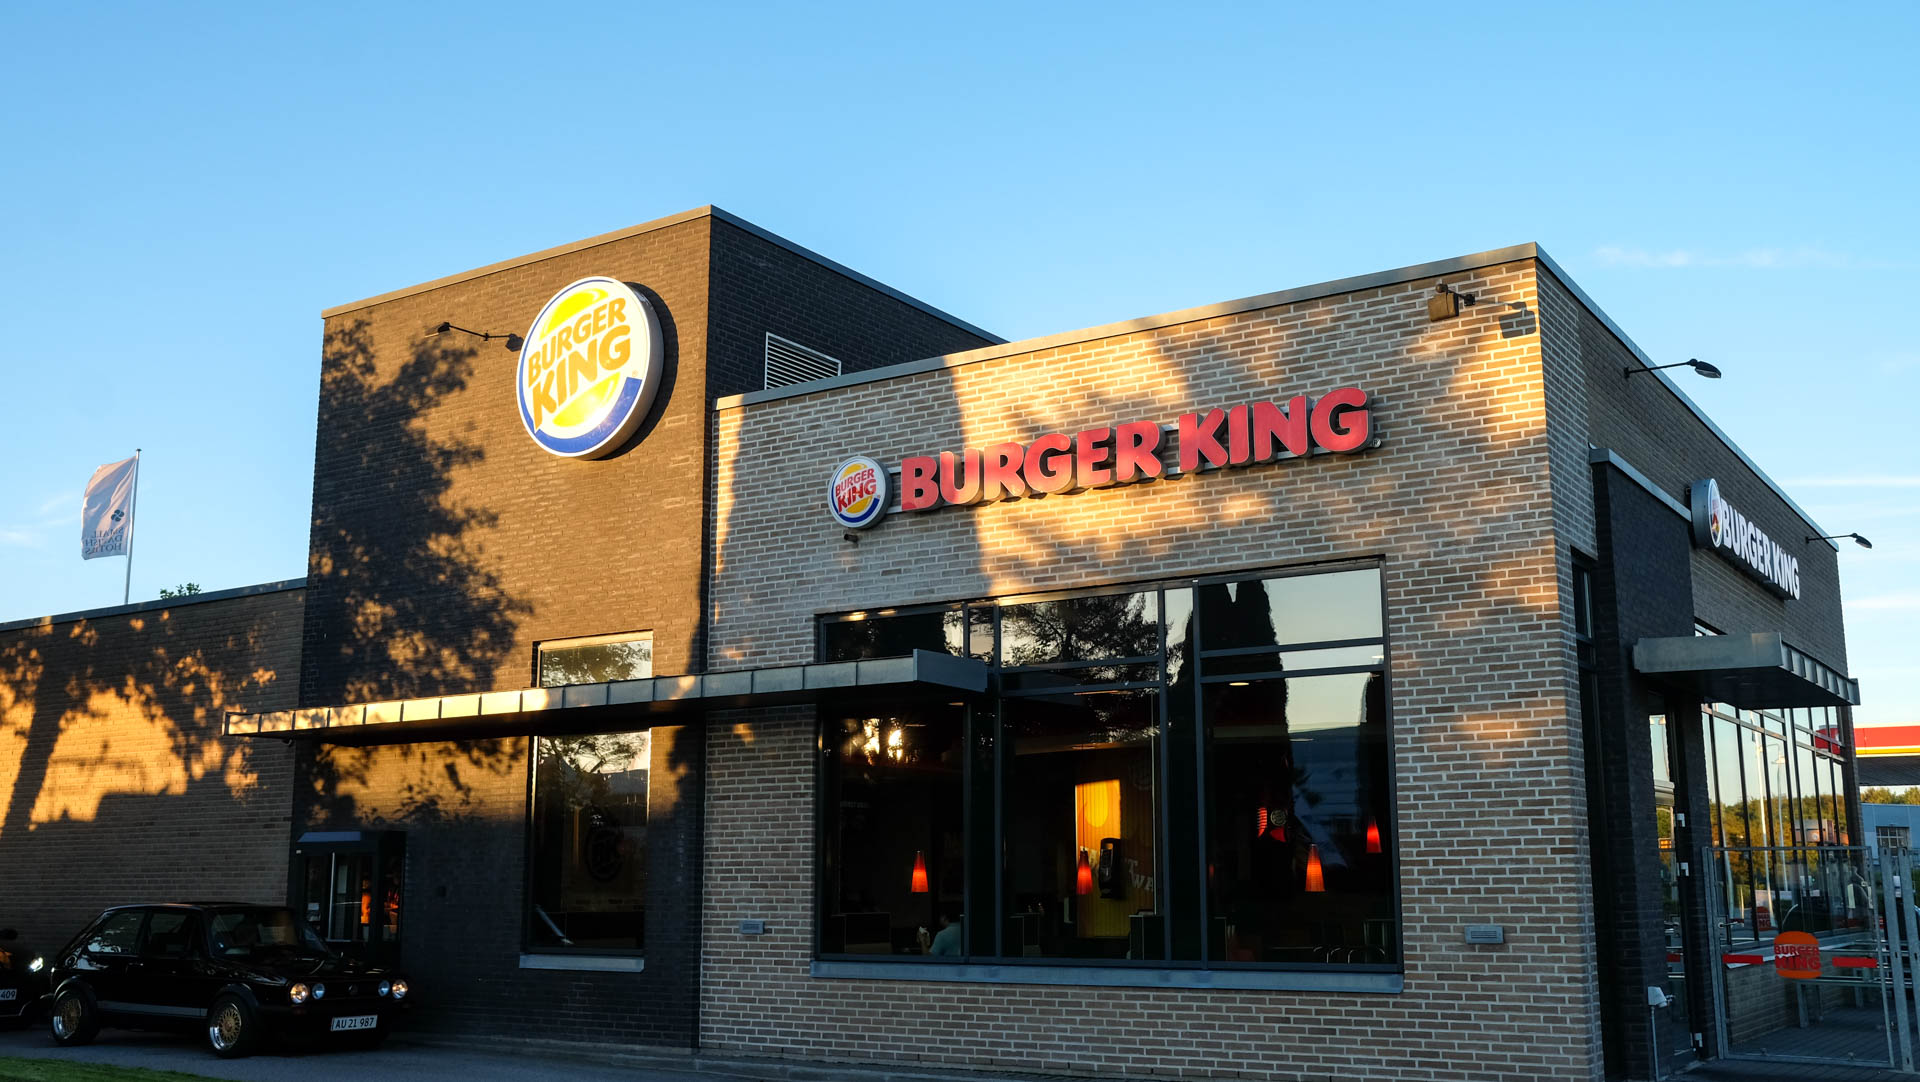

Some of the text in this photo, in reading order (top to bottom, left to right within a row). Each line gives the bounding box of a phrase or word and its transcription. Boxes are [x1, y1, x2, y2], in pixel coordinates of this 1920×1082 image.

[528, 297, 626, 388] BURGER
[532, 324, 631, 432] KING
[900, 387, 1369, 511] BURGER KING
[835, 468, 875, 497] BURGER
[837, 479, 877, 513] KING
[1721, 498, 1800, 600] BURGER KING
[1774, 944, 1820, 956] BURGER
[335, 1017, 375, 1029] AU 21 987
